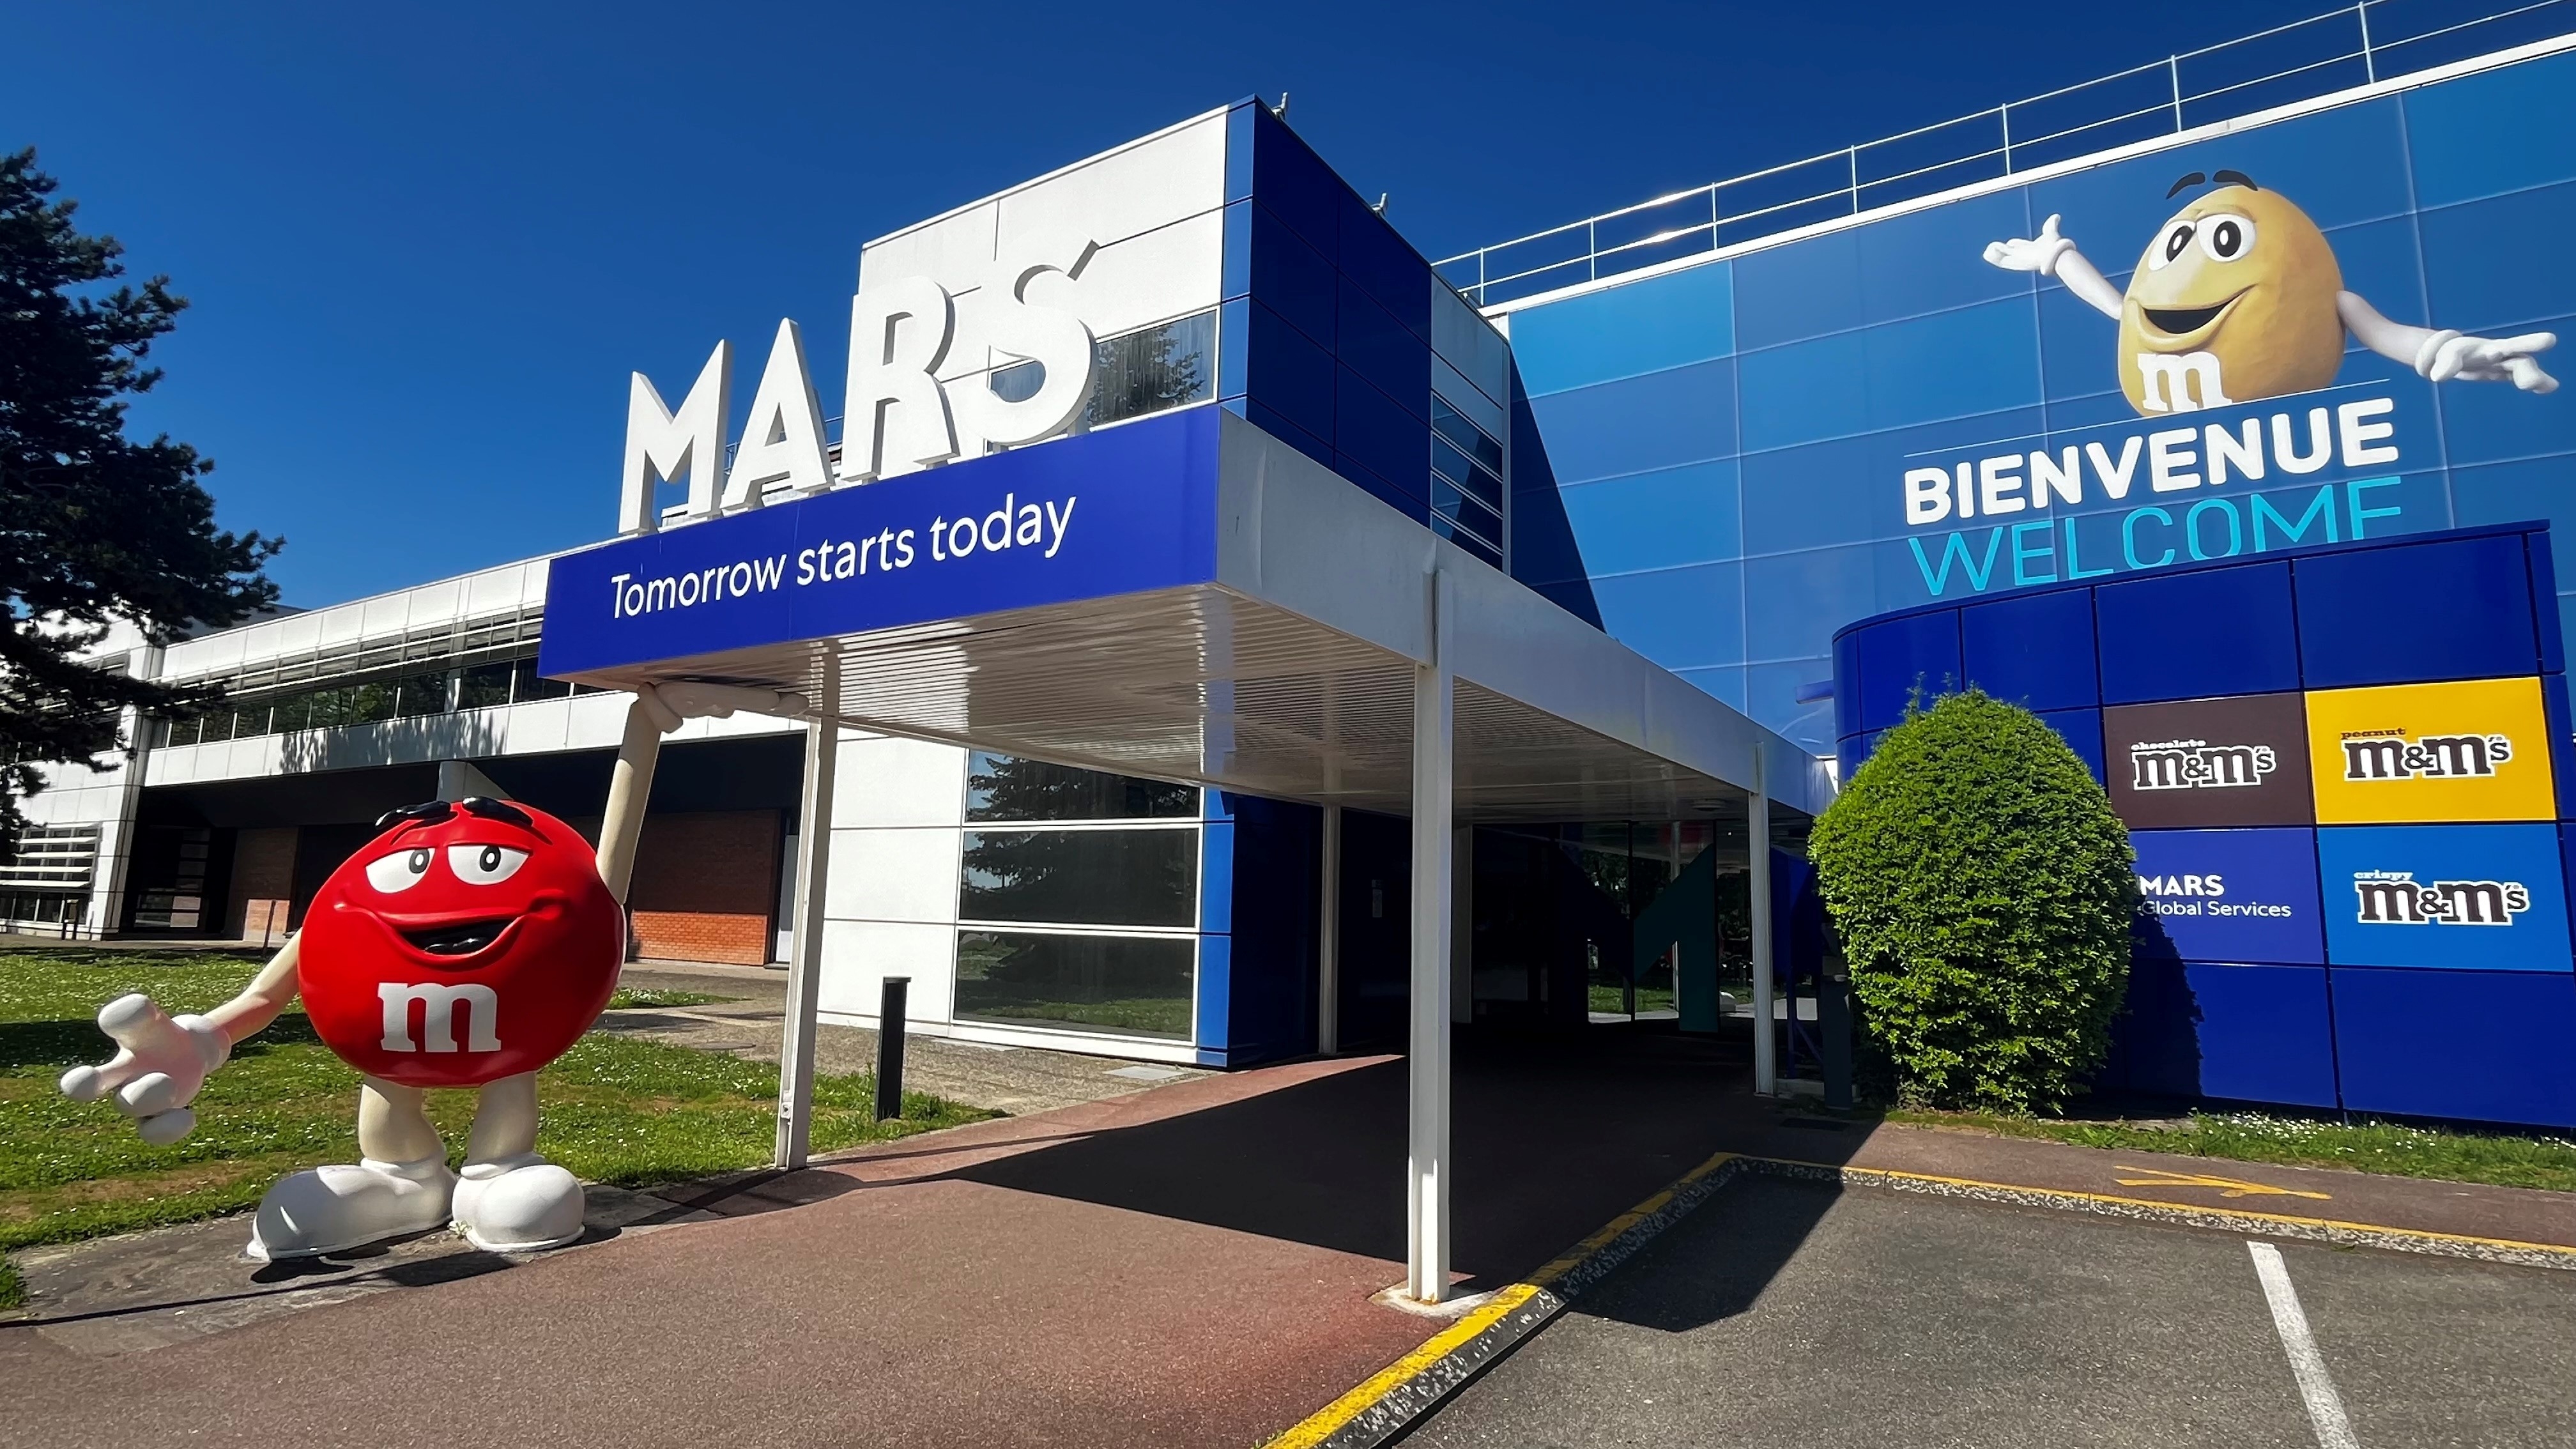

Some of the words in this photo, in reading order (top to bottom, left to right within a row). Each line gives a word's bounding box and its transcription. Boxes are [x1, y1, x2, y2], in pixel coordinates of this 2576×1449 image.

[617, 236, 1100, 535] MARS
[2137, 351, 2232, 411] m
[1903, 397, 2399, 526] BIENVENUE
[610, 552, 788, 619] Tomorrow
[795, 525, 915, 585] starts
[928, 492, 1077, 561] today
[1908, 476, 2402, 596] WELCOME
[2340, 727, 2406, 740] peanut
[2139, 874, 2225, 897] MARS
[2354, 870, 2413, 880] crispy
[2207, 901, 2292, 917] Services
[377, 982, 502, 1053] m
